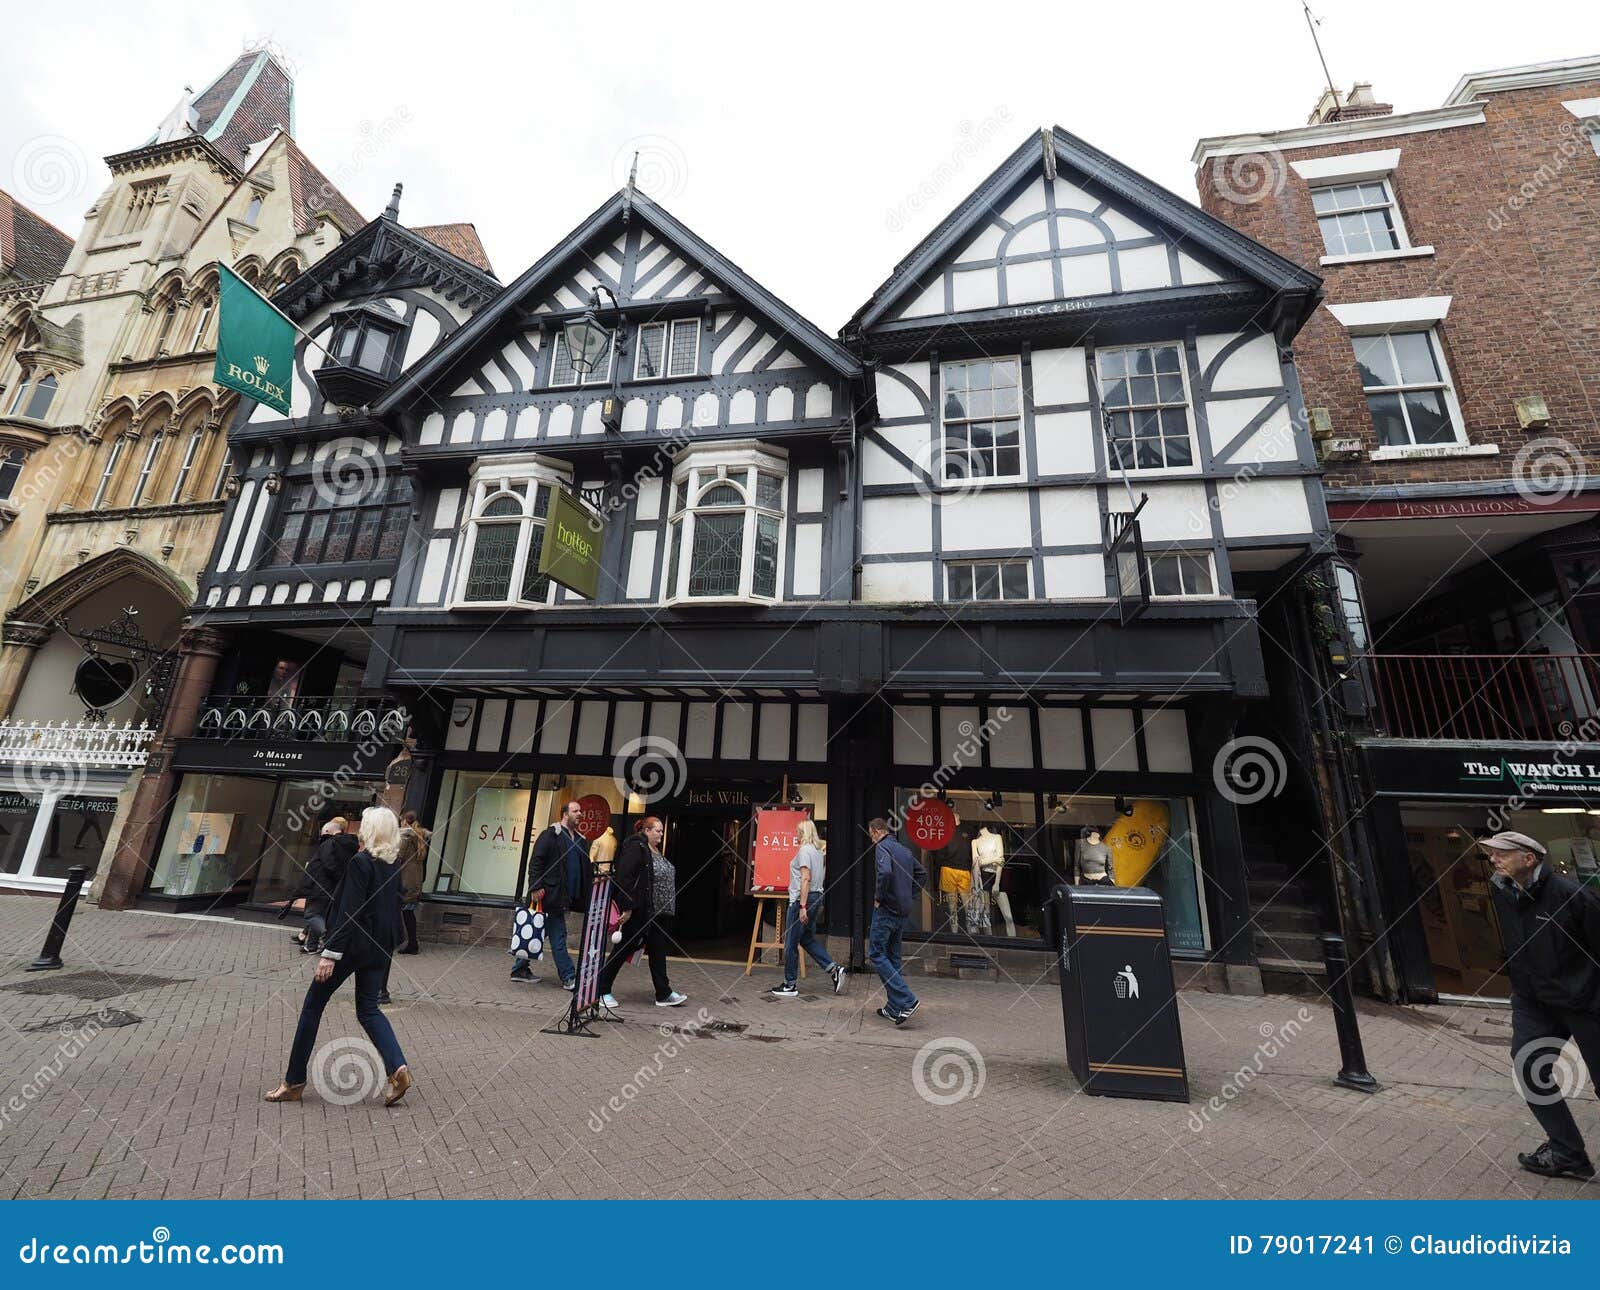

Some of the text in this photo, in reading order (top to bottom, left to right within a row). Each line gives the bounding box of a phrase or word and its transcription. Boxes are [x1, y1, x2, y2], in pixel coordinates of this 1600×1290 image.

[228, 363, 284, 402] ROLEX
[557, 521, 593, 557] hotter
[266, 751, 303, 760] MALONE
[1463, 762, 1501, 775] The
[1507, 763, 1584, 777] WATCH
[1530, 783, 1560, 791] Quality
[687, 790, 750, 806] Jack Wills
[71, 801, 84, 810] TEA
[86, 801, 110, 812] PRESS
[578, 822, 601, 832] OFF
[916, 815, 944, 827] 40%
[479, 825, 536, 843] SALE
[916, 828, 945, 840] OFF
[763, 836, 799, 847] SALE
